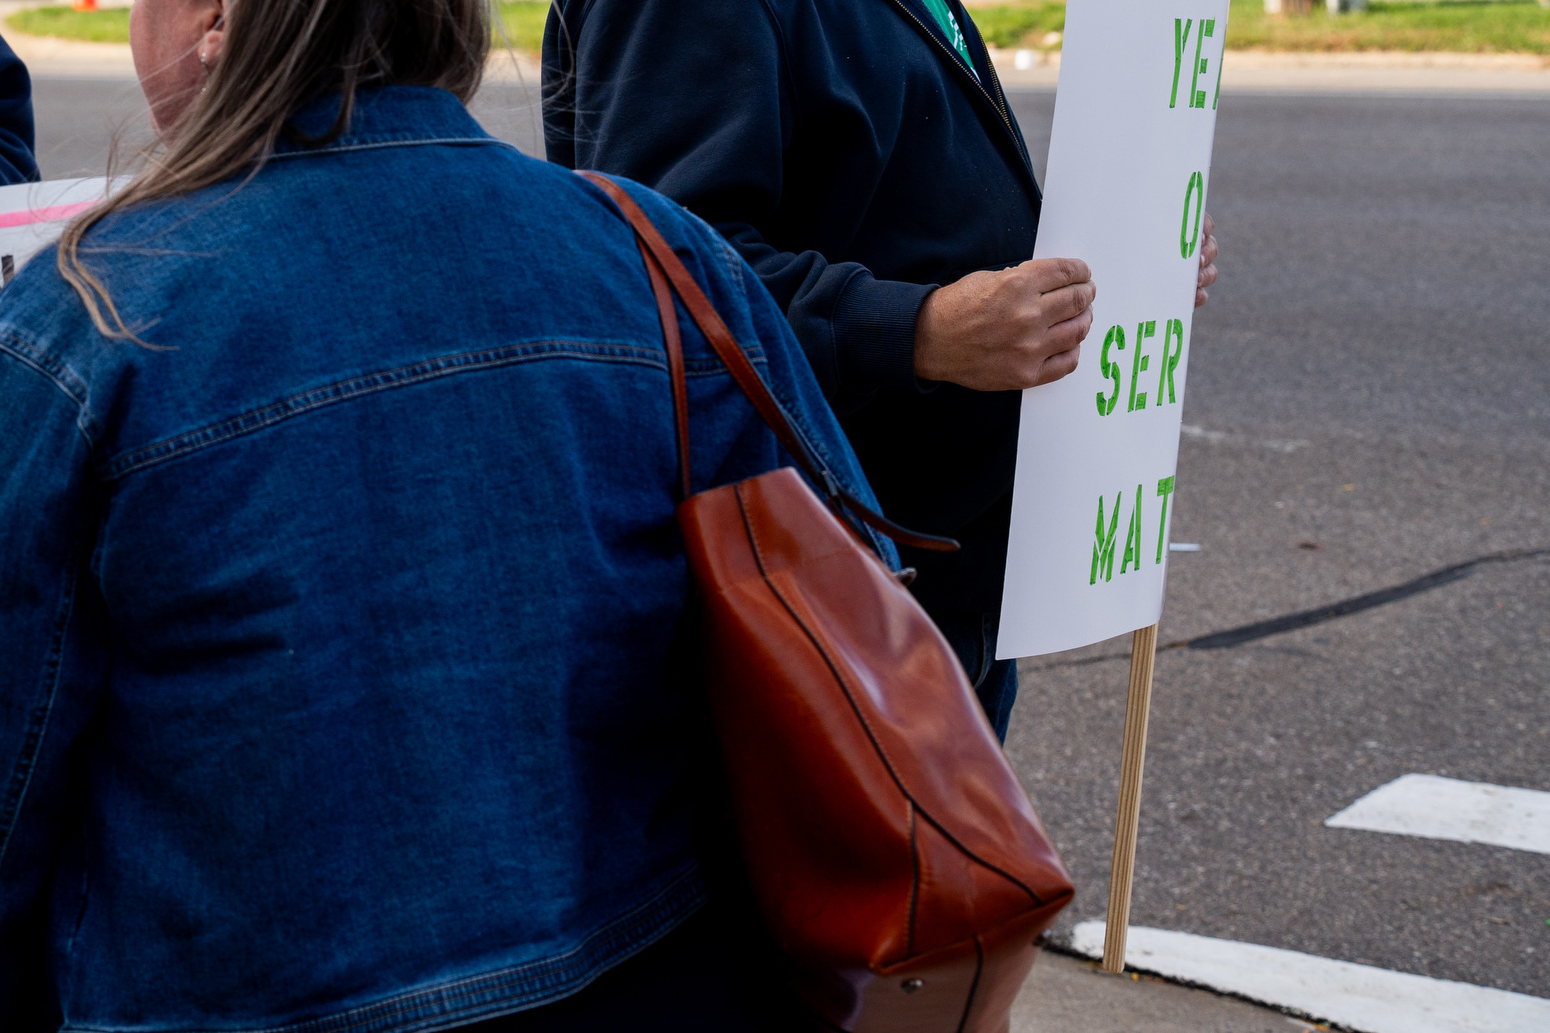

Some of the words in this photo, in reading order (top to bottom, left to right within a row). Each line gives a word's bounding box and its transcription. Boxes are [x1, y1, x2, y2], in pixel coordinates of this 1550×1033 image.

[1169, 17, 1225, 110] YE
[1096, 319, 1183, 416] SER
[1090, 475, 1175, 585] MAT
